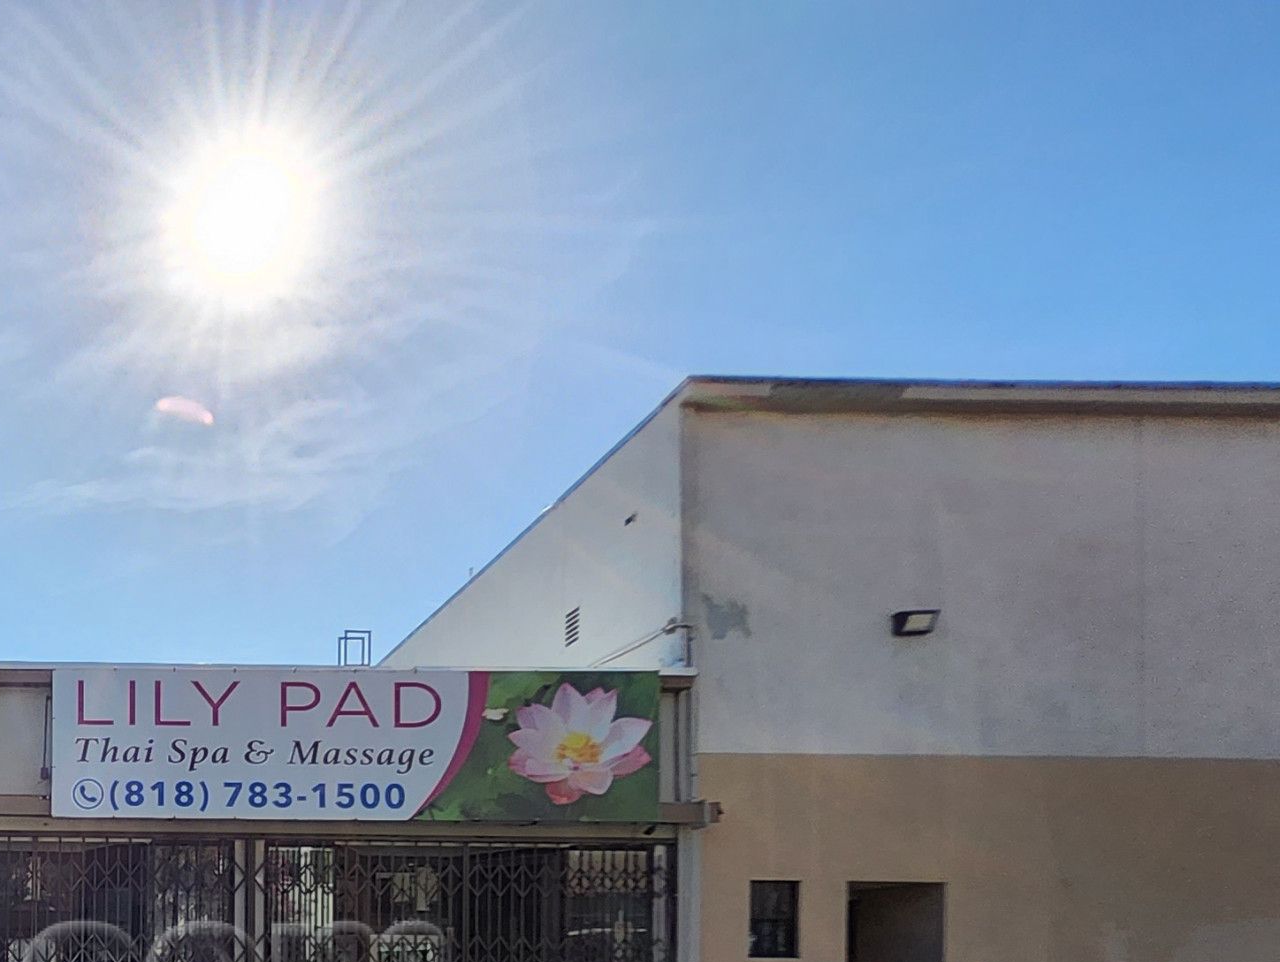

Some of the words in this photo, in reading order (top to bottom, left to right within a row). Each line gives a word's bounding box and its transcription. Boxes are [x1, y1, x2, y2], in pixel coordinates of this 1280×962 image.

[76, 679, 241, 727] LILY
[280, 680, 442, 729] PAD
[74, 736, 154, 763] Thai
[167, 737, 230, 772] Spa
[243, 739, 275, 766] &
[286, 739, 436, 775] Massage
[109, 779, 210, 813] (818)
[222, 780, 407, 811] 783-1500
